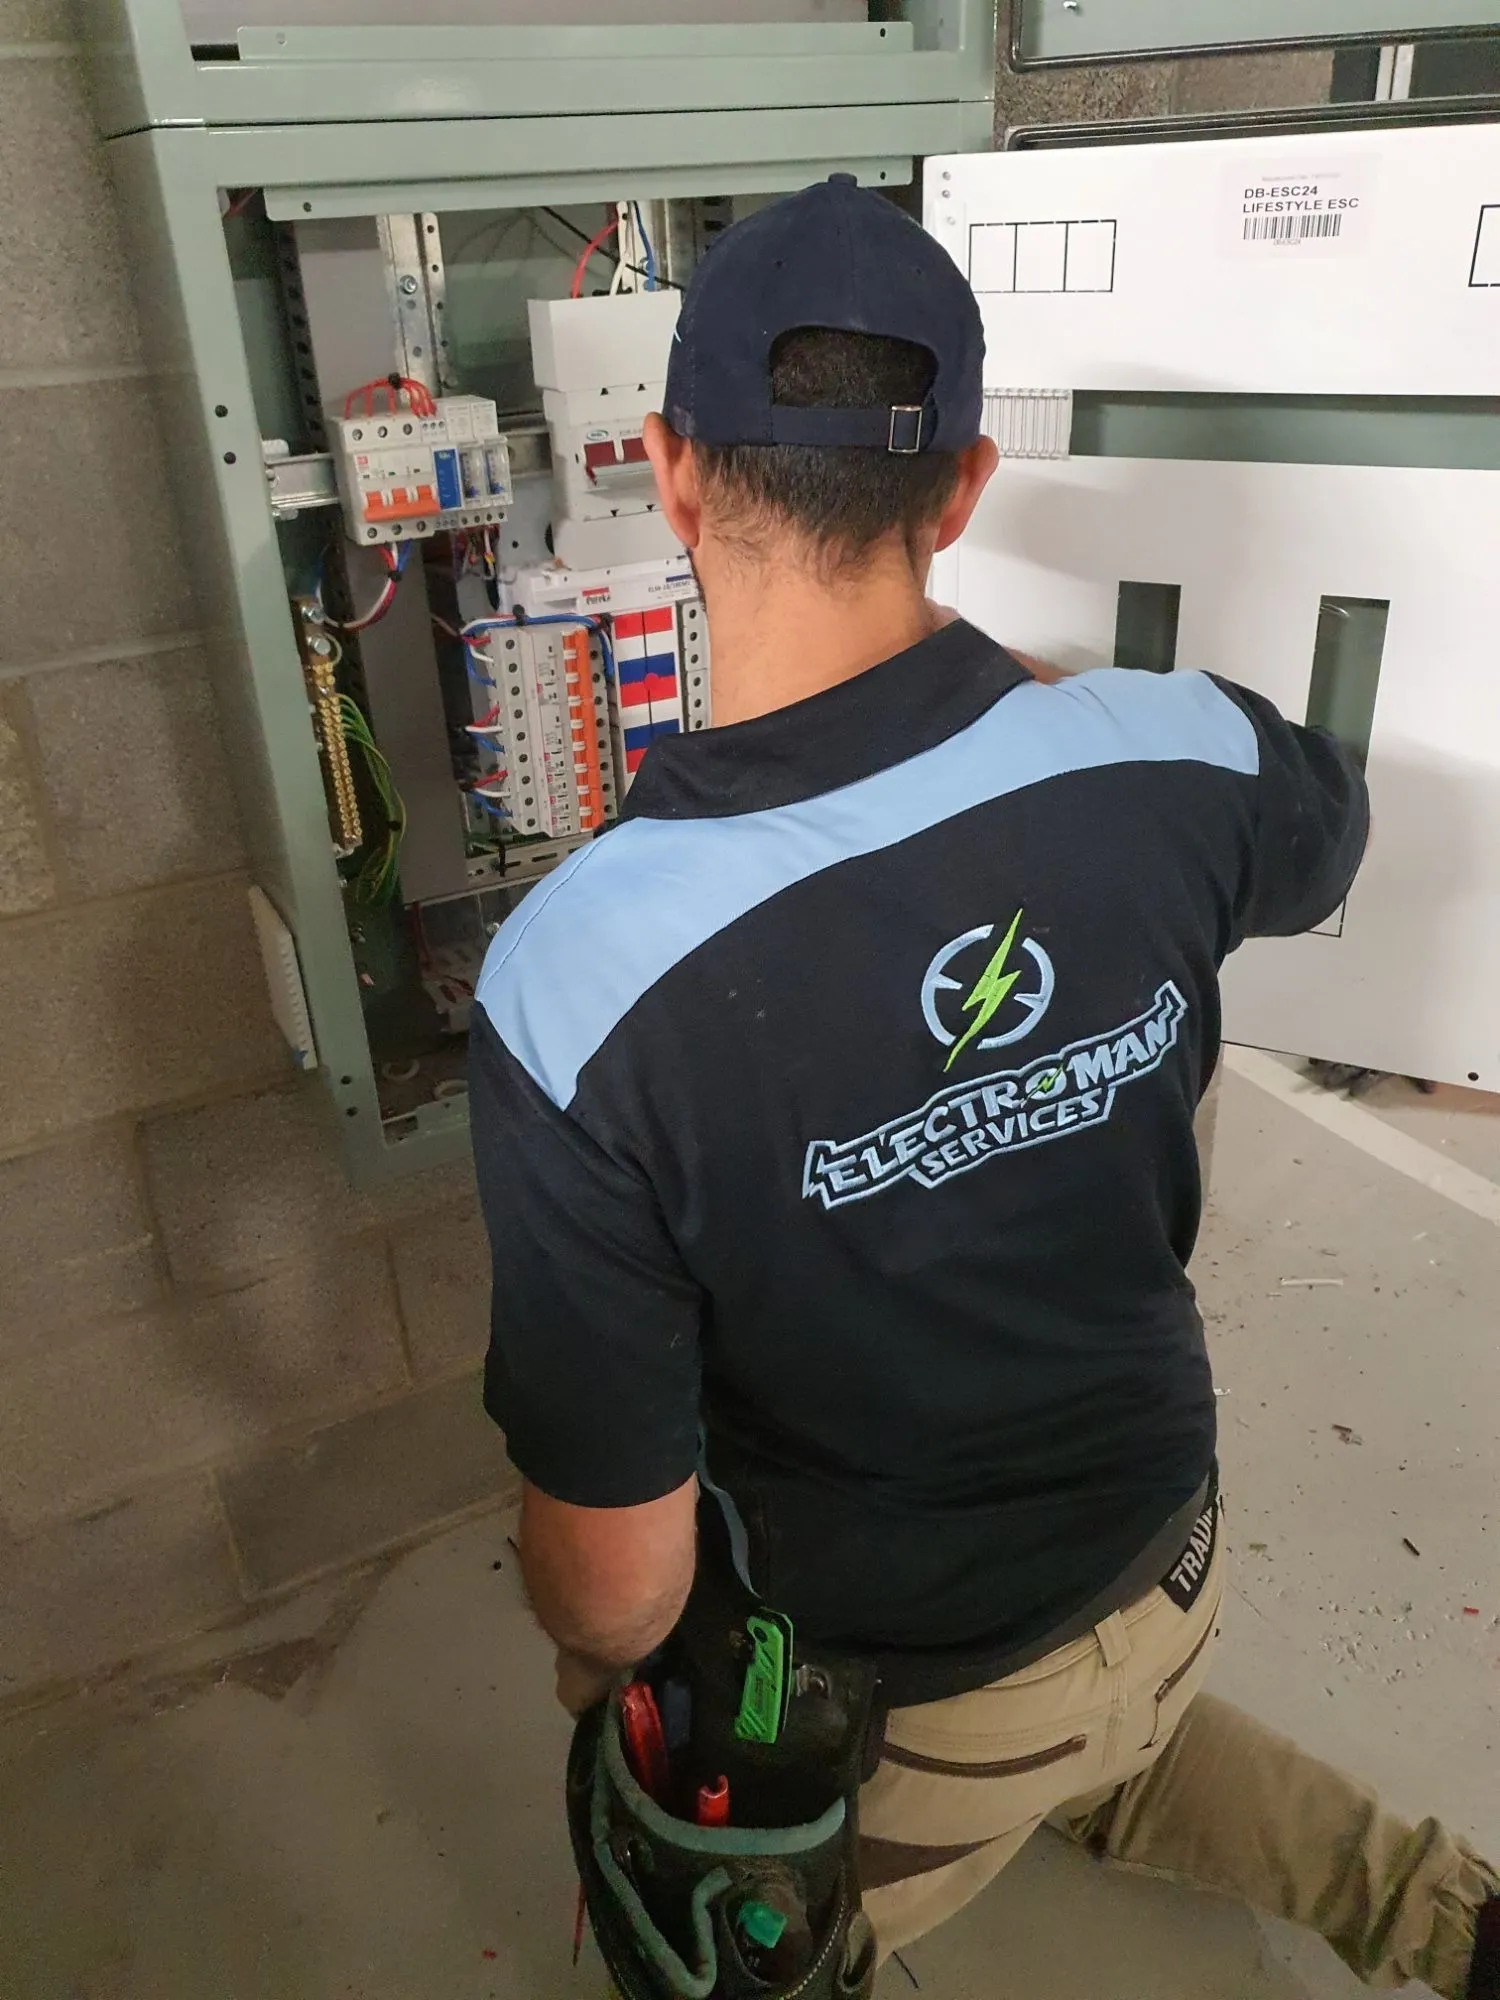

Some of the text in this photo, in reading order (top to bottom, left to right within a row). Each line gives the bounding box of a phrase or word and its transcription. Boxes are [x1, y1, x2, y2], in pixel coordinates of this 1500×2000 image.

[1242, 197, 1360, 213] LIFESTYLE ESC
[1244, 185, 1319, 199] DB-ESC24
[816, 995, 1174, 1192] ELECTROMAN
[920, 1087, 1103, 1175] SERVICES
